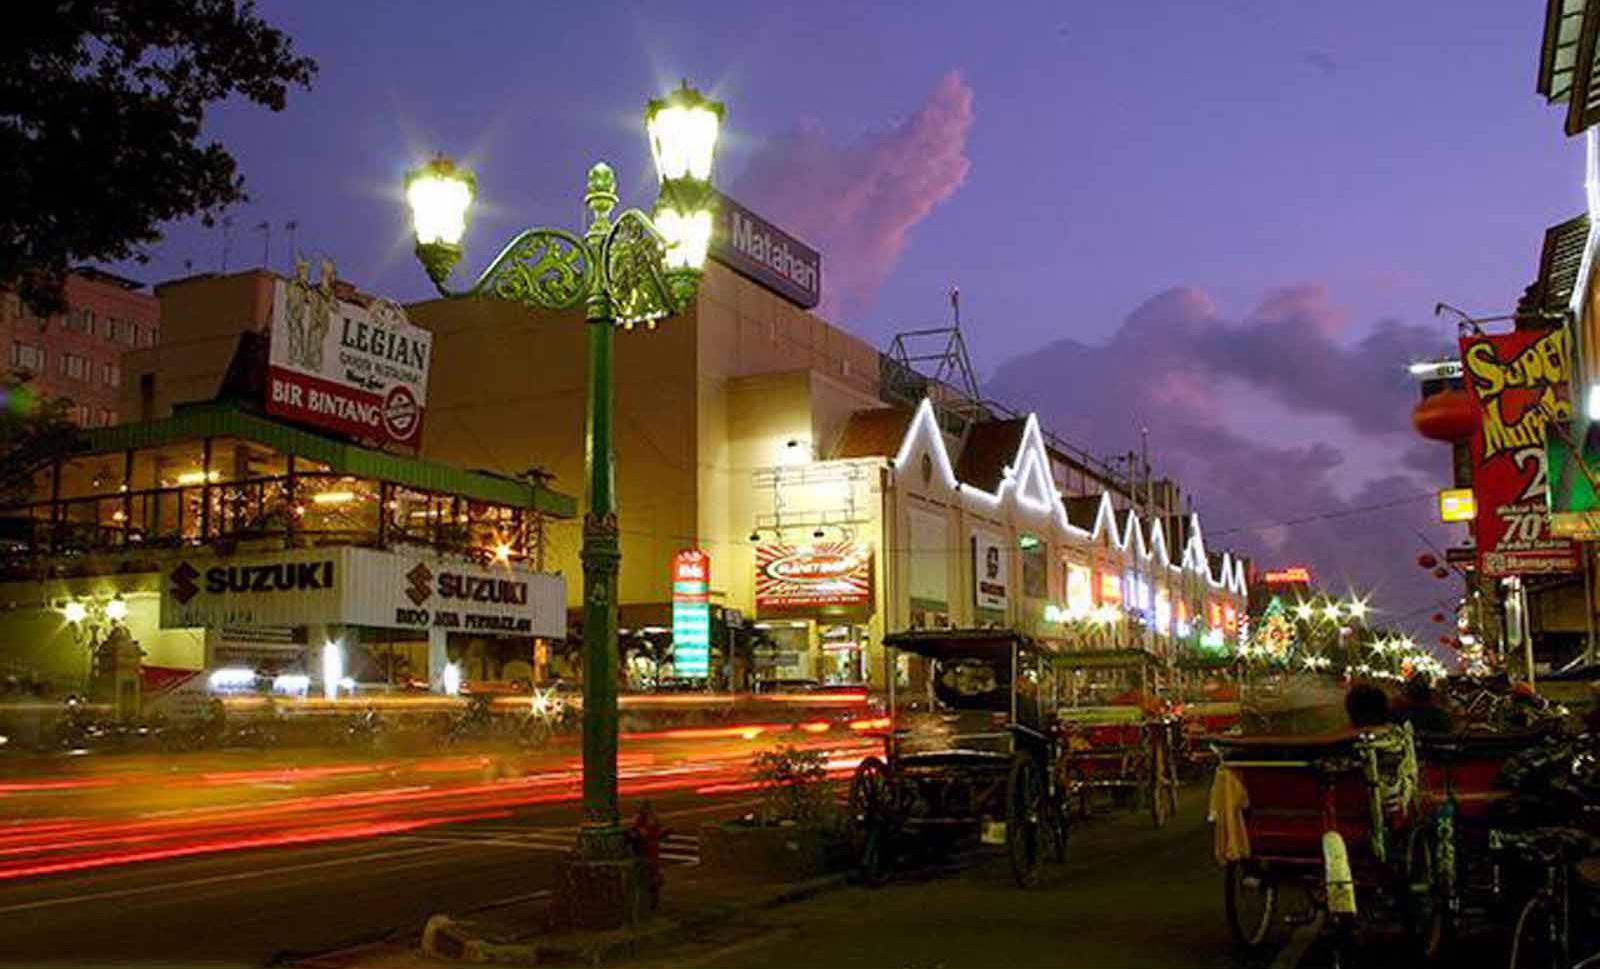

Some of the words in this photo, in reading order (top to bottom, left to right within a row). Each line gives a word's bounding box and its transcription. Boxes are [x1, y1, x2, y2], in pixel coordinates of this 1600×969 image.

[733, 212, 818, 293] Matahari
[340, 318, 427, 370] LEGIAN
[272, 379, 302, 408] BIR
[308, 388, 381, 427] BINTANG
[205, 561, 334, 594] SUZUKI
[438, 572, 527, 605] SUZUKI
